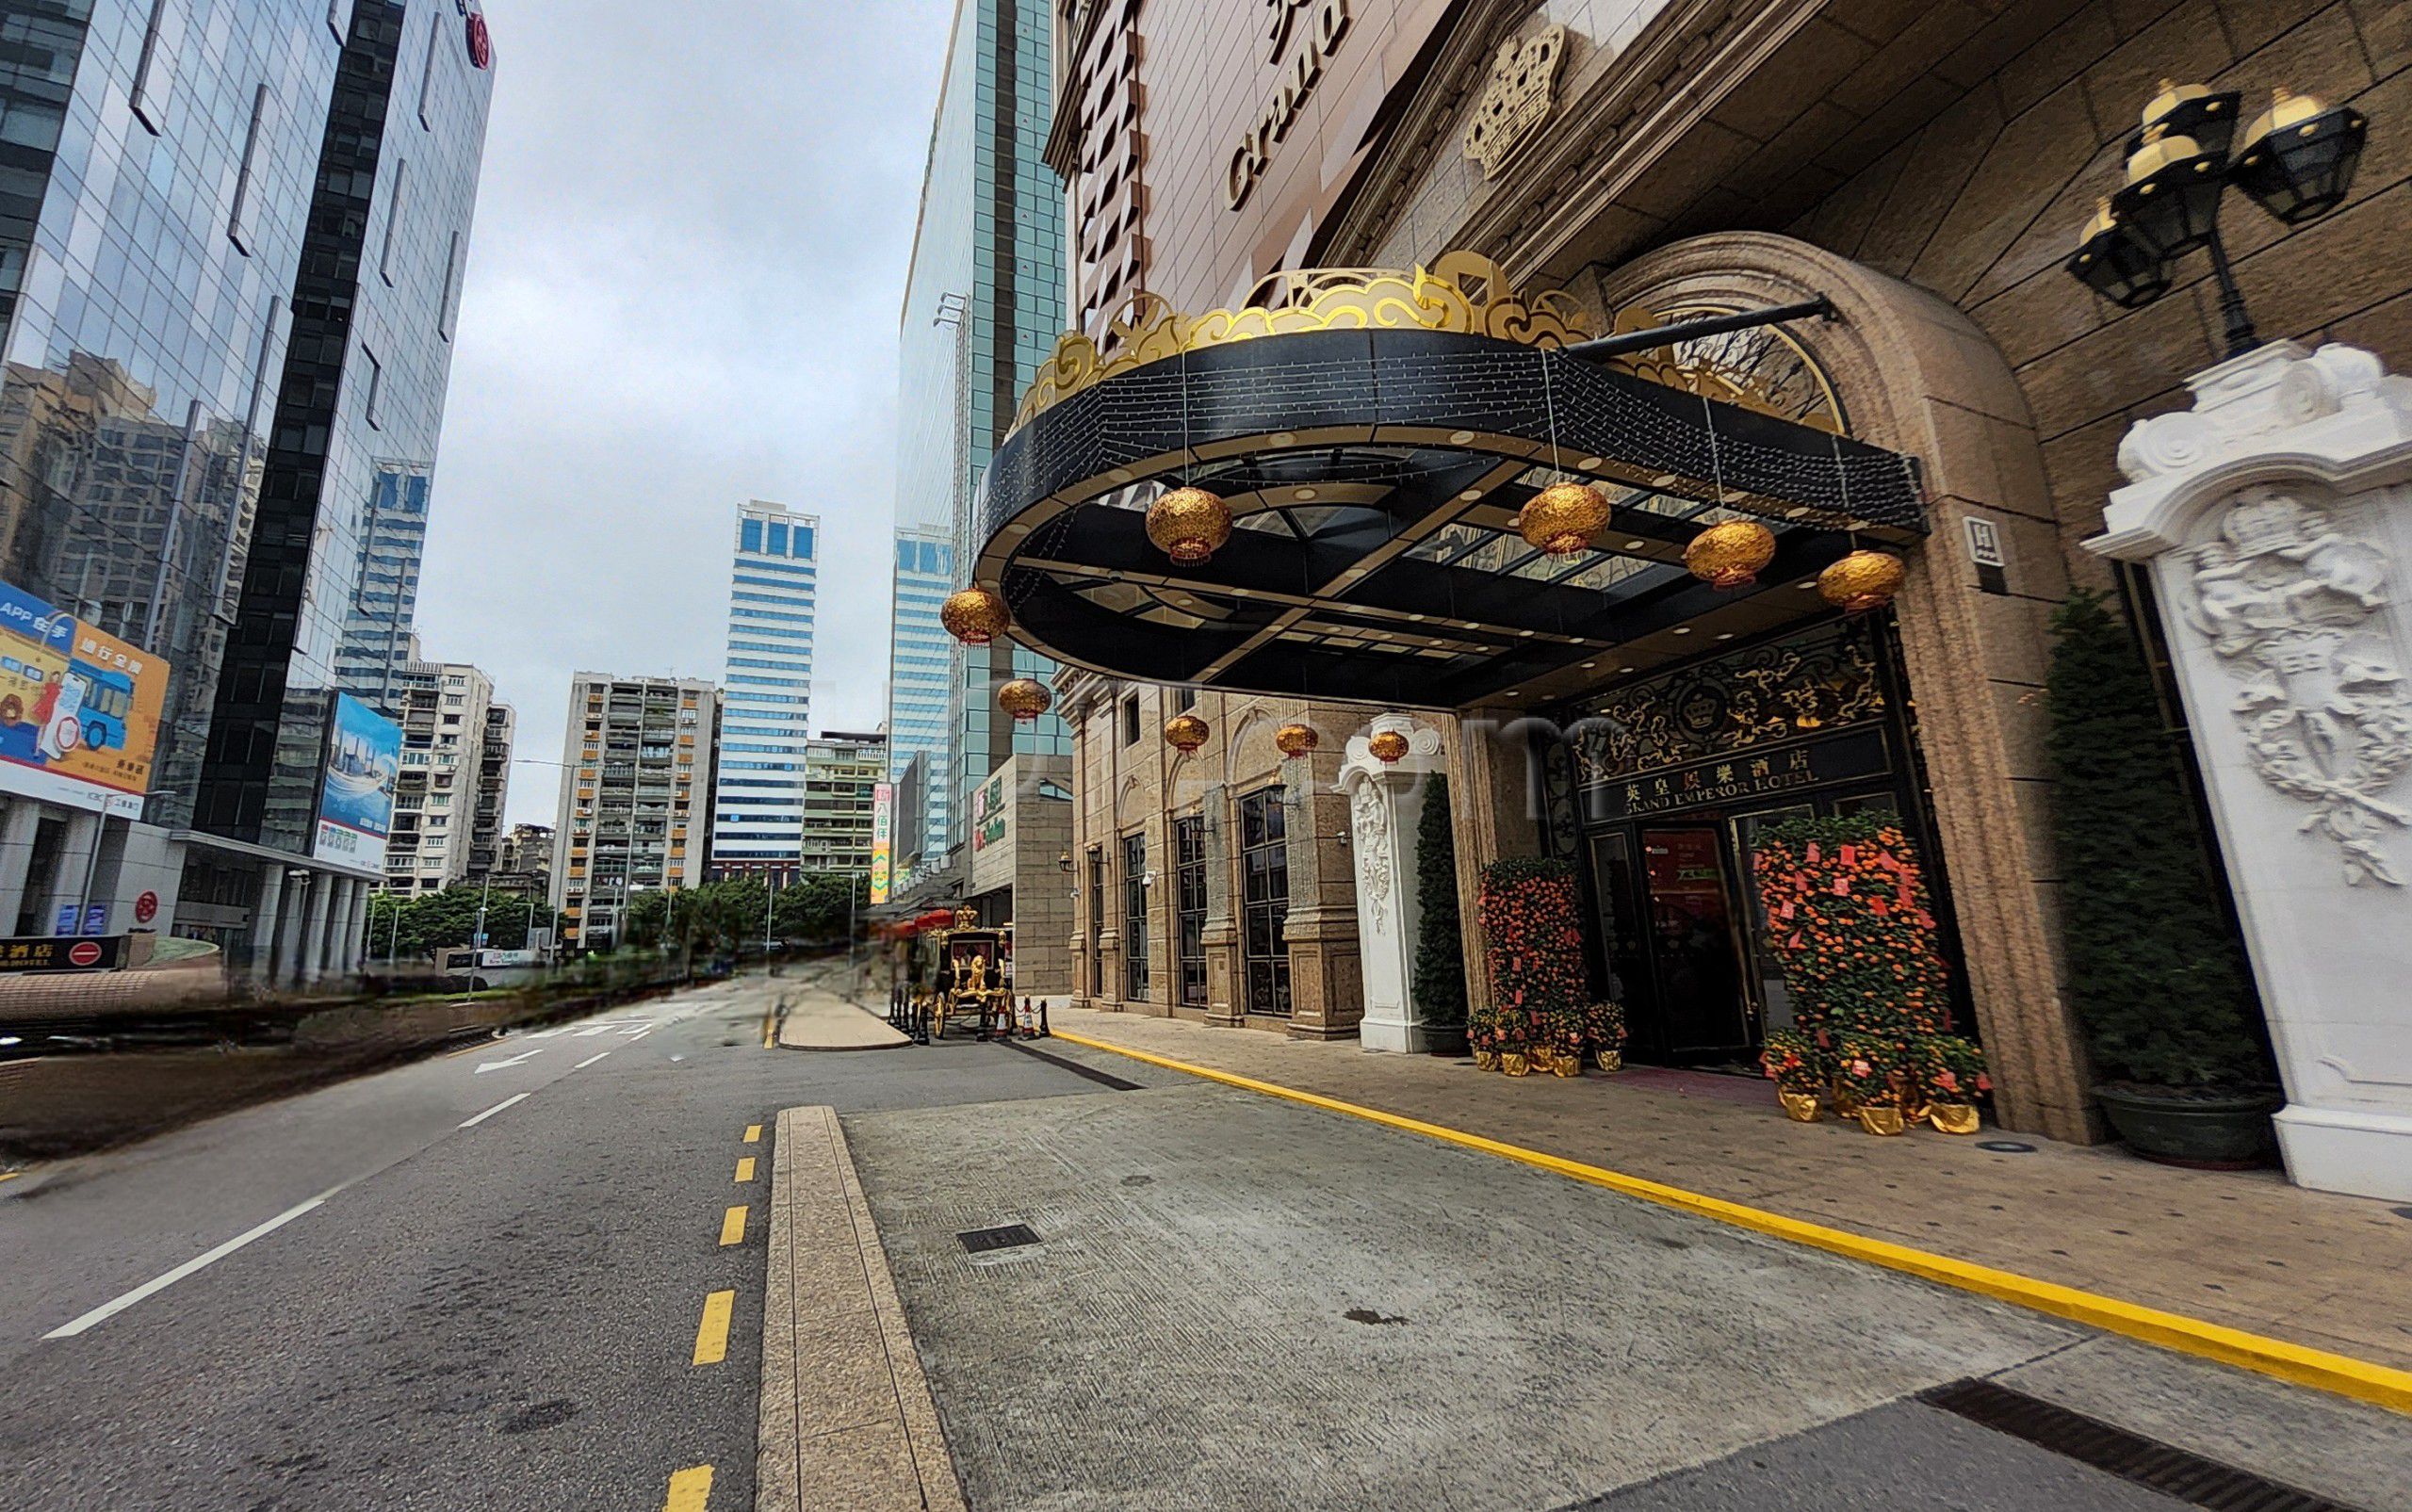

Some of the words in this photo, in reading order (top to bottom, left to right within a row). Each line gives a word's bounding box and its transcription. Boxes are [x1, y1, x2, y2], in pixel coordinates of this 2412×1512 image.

[1625, 797, 1670, 815] GRAND
[1675, 782, 1751, 806] EMPEROR
[1754, 769, 1820, 791] HOTEL
